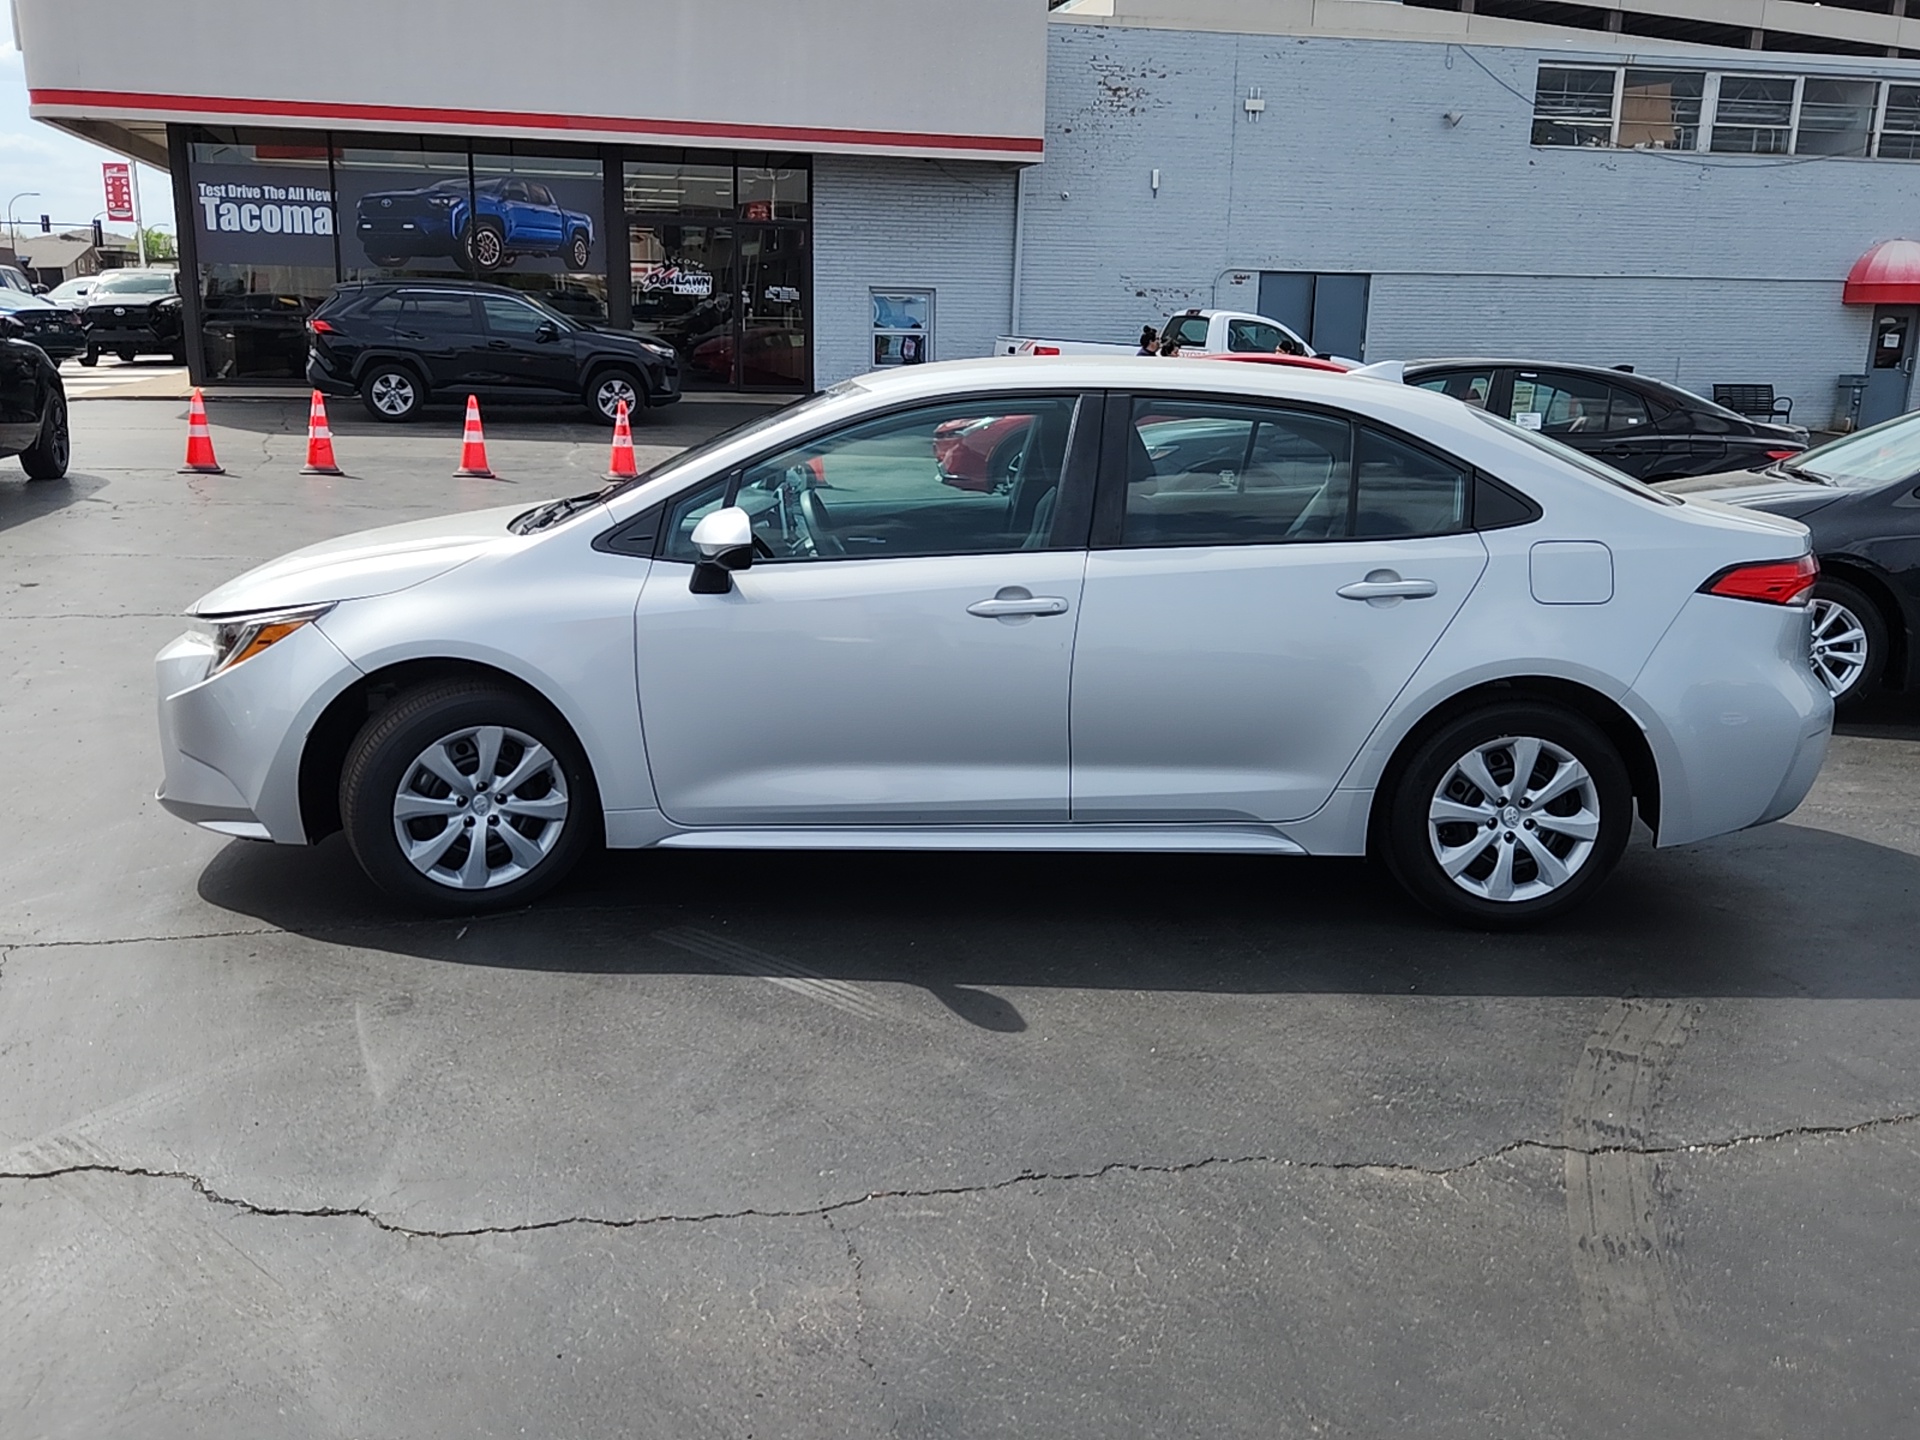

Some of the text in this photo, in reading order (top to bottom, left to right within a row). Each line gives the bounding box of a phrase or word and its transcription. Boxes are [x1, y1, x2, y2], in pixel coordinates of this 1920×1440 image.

[106, 177, 116, 208] USED
[120, 178, 130, 208] CARS
[198, 183, 338, 202] Test Drive The All New
[199, 197, 340, 235] Tacoma
